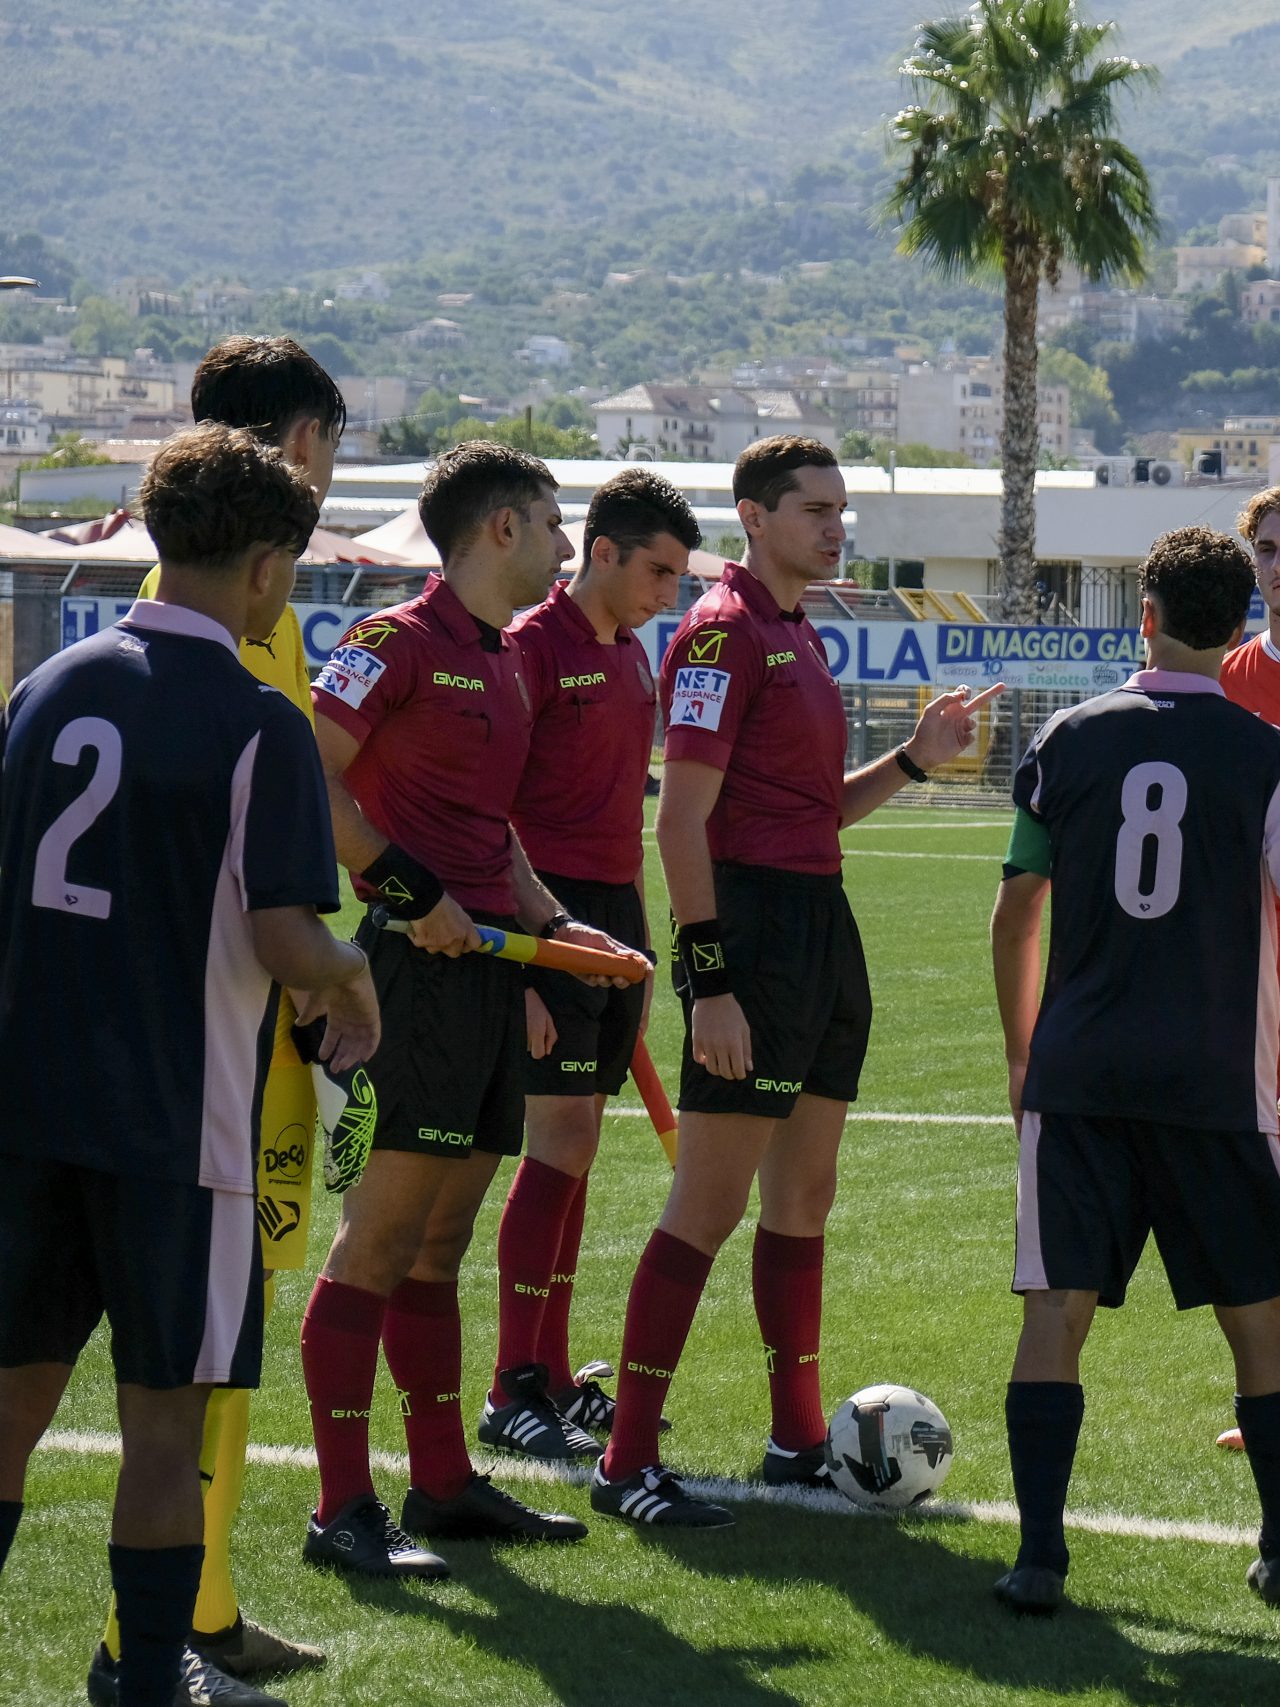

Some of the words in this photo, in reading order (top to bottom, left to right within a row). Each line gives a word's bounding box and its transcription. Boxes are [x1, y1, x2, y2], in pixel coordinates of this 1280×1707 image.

[946, 629, 973, 656] DI
[981, 630, 1089, 660] MAGGIO
[433, 672, 485, 692] GIVOVA
[560, 672, 607, 688] GIVOVA
[677, 670, 727, 692] NET
[1027, 673, 1088, 686] Enalotto
[32, 716, 123, 919] 2
[1114, 761, 1188, 920] 8
[755, 1078, 802, 1093] GIVOVA
[418, 1127, 473, 1147] GIVOVA
